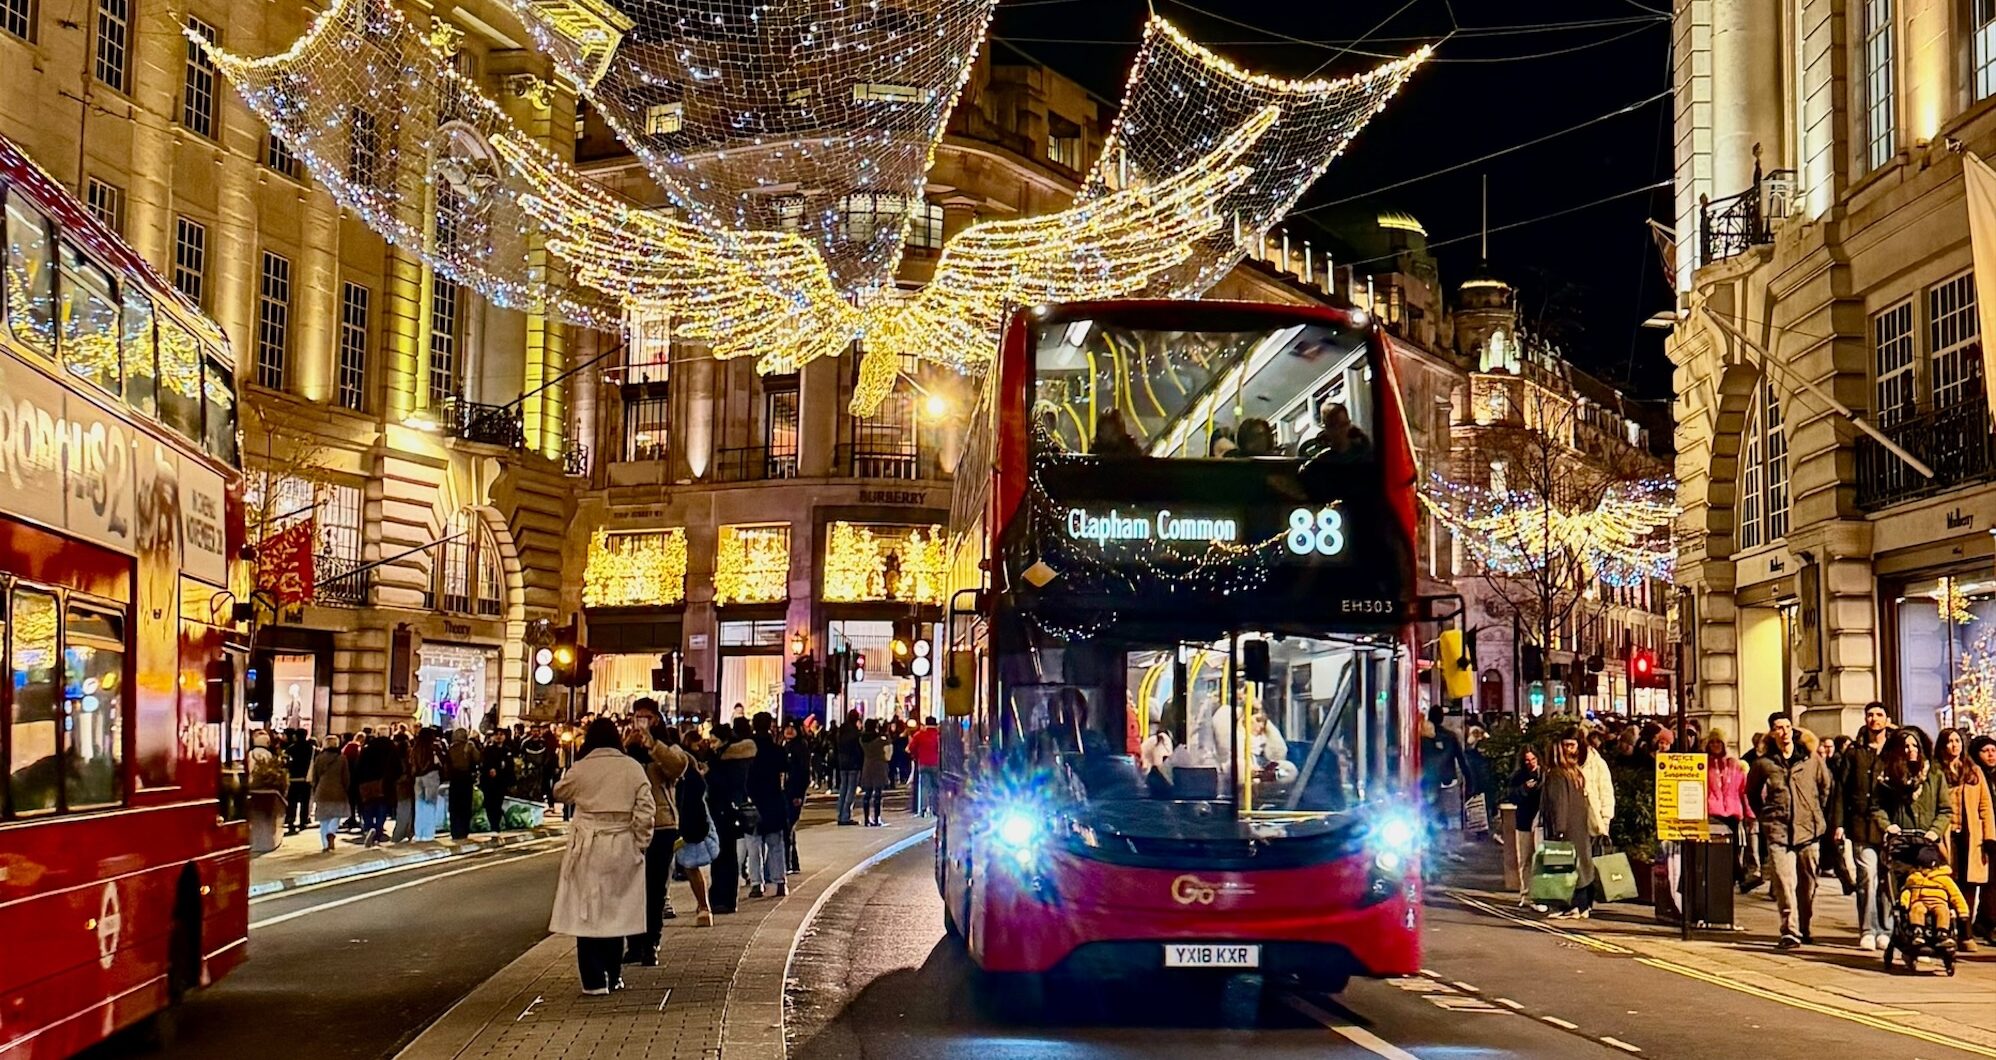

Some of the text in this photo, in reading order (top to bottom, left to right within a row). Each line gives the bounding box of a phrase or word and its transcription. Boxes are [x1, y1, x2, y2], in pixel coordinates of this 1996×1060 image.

[107, 424, 128, 538] 2
[859, 490, 927, 504] BURBERRY
[1068, 508, 1236, 547] Clapham Common
[1287, 507, 1344, 556] 88
[1341, 599, 1393, 613] EH303
[443, 620, 471, 640] Theory
[1171, 875, 1215, 905] Go
[1176, 947, 1247, 963] YX18 KXR
